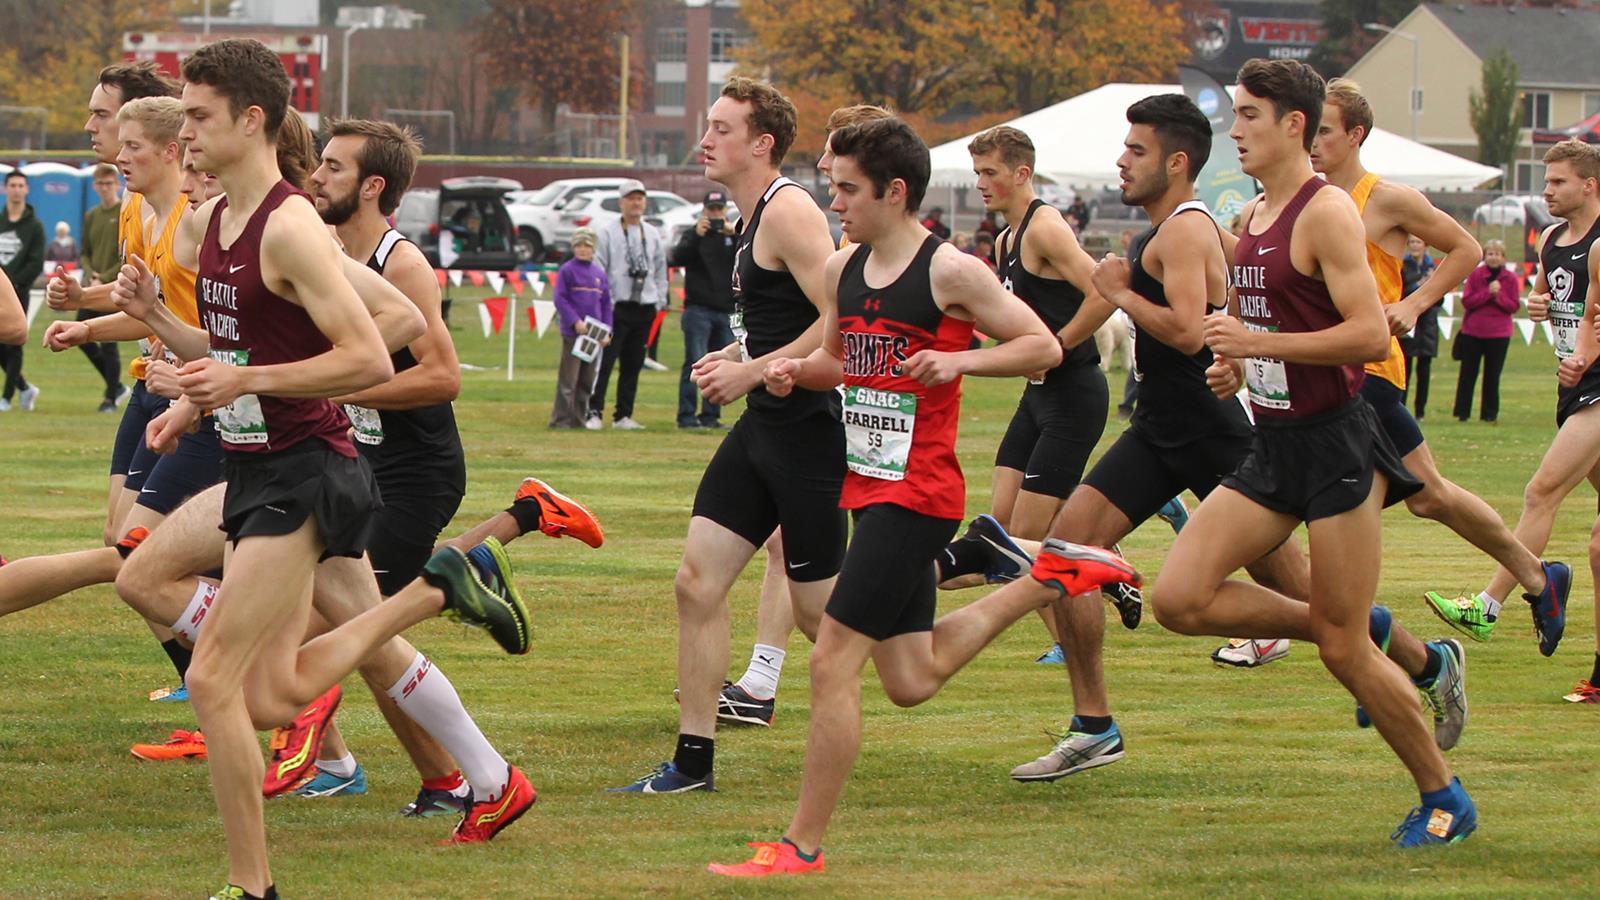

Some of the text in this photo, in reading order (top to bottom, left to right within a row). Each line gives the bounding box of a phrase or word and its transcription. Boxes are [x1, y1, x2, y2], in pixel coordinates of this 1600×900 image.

[201, 277, 238, 310] SEATTLE
[1550, 301, 1575, 313] GNAC
[855, 388, 901, 409] GNAC
[845, 410, 910, 433] FARRELL
[867, 432, 883, 448] 59
